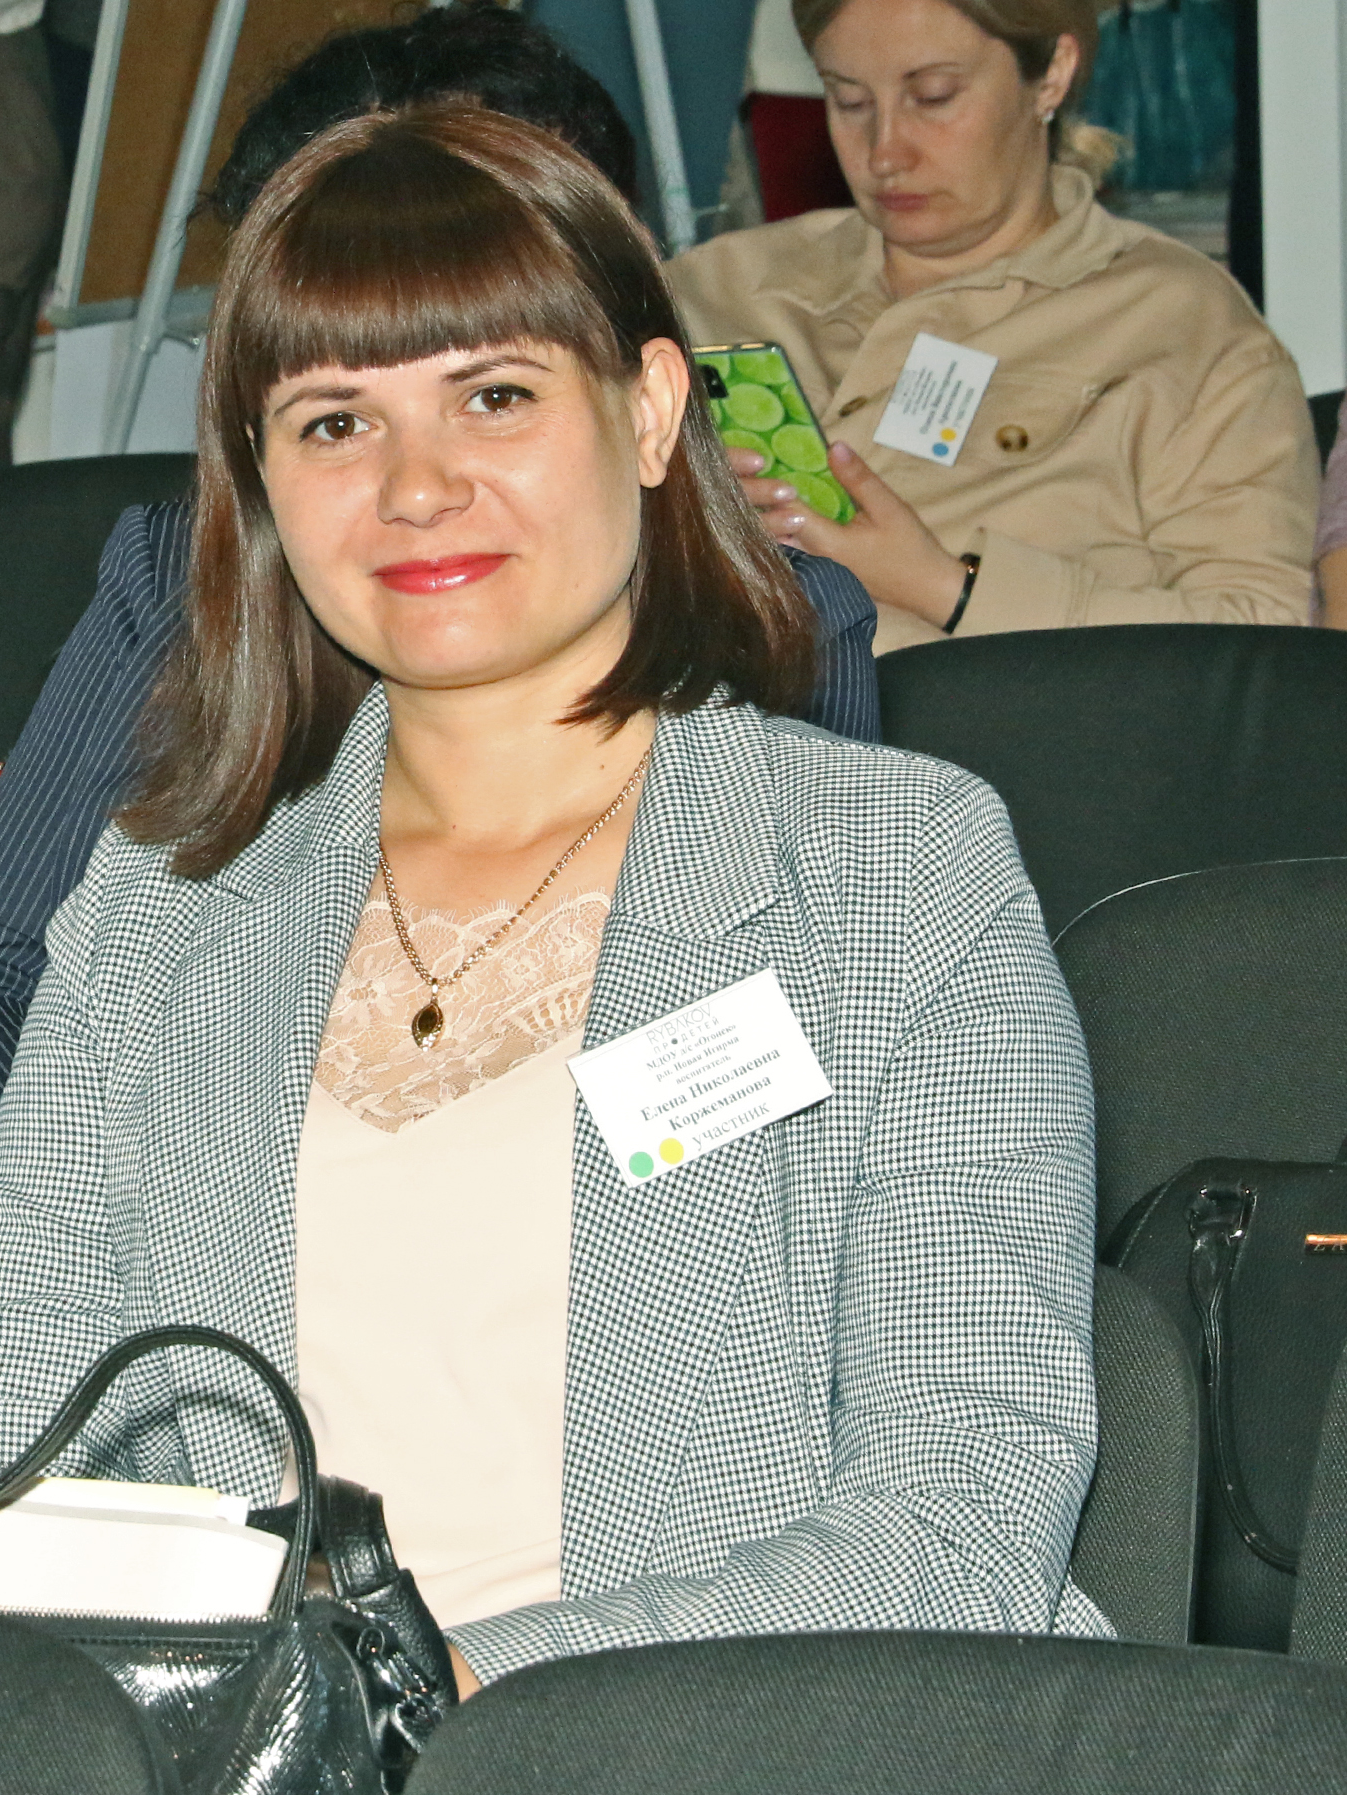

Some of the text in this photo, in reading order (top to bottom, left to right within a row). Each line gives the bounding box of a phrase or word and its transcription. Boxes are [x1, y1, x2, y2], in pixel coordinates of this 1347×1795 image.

[646, 1051, 677, 1071] МДОУ
[673, 1054, 703, 1072] Новая
[675, 1055, 732, 1085] воспитатель
[640, 1049, 781, 1122] Елена Николаевна
[668, 1076, 772, 1132] Коржеманова
[691, 1102, 770, 1152] участник
